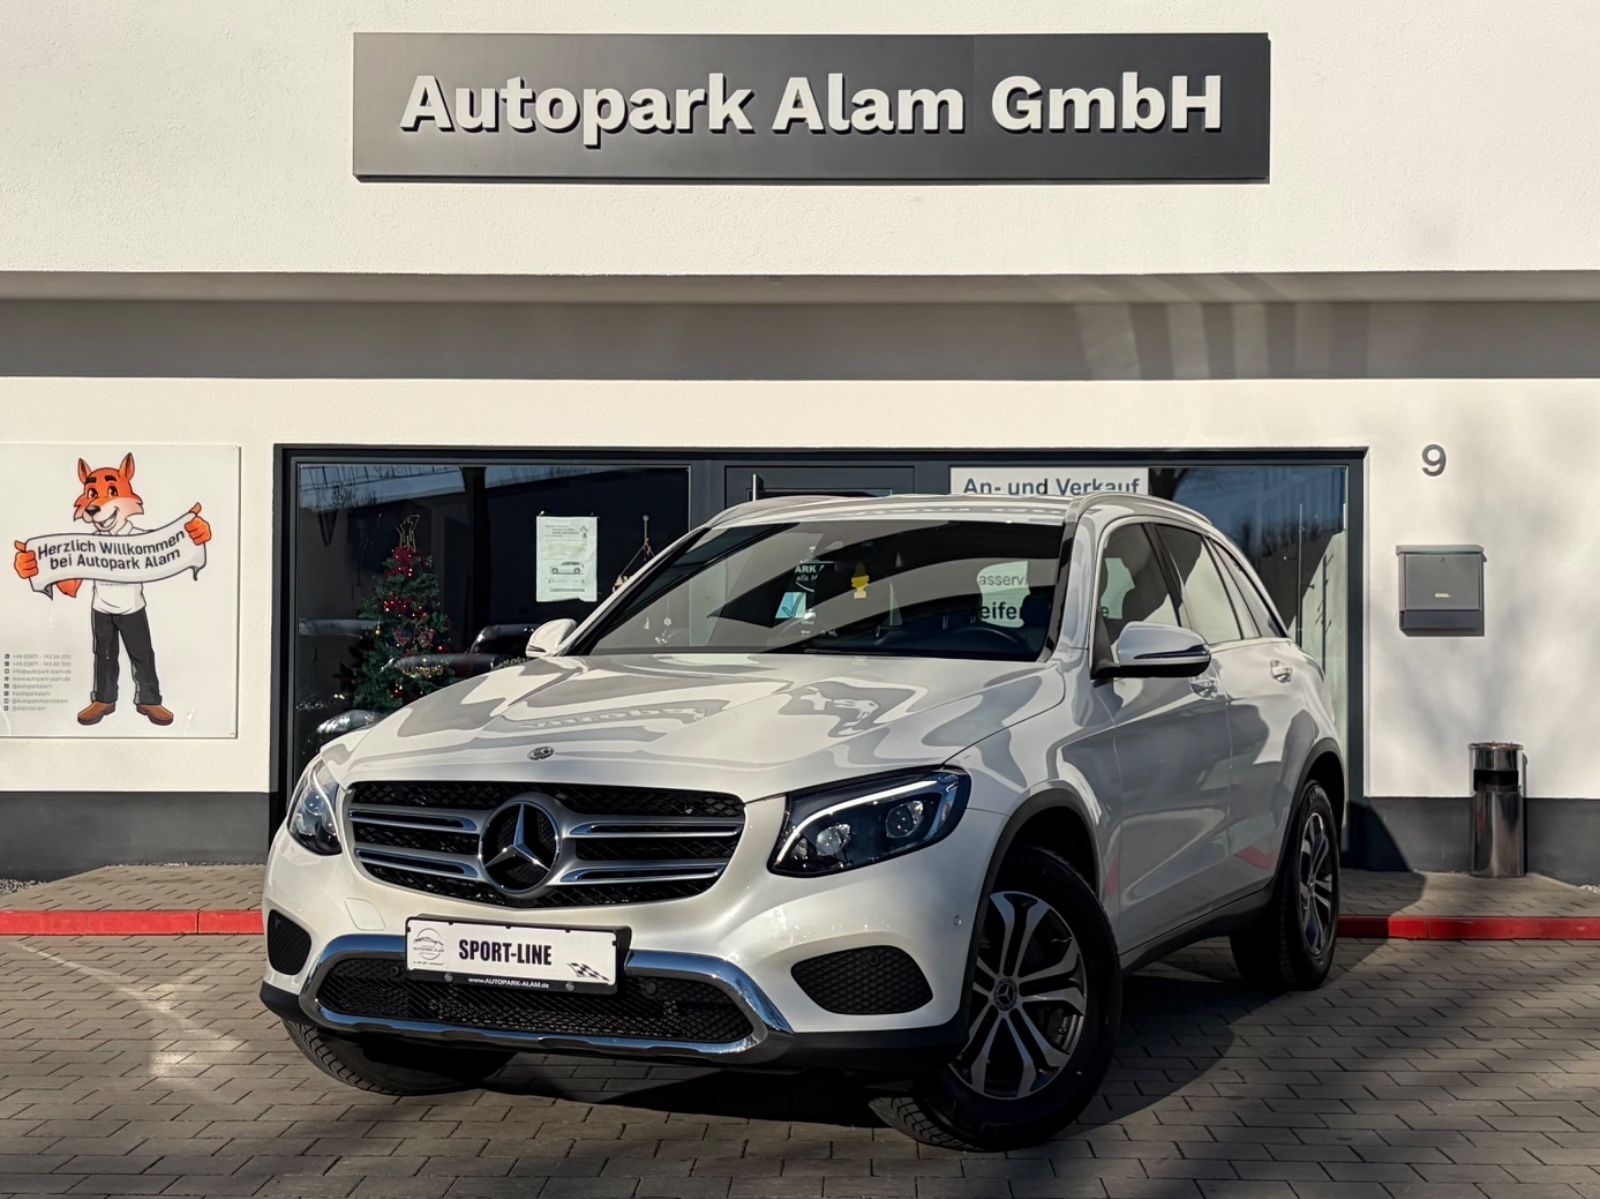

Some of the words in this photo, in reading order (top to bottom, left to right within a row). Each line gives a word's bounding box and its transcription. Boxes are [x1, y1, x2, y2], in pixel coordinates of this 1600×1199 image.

[400, 73, 753, 147] Autopark
[772, 73, 964, 132] Alam
[992, 72, 1221, 131] GmbH
[1422, 444, 1447, 477] 9
[964, 478, 1001, 494] An-
[1008, 478, 1048, 495] und
[38, 539, 95, 560] Herzlich
[100, 530, 185, 556] Willkommen
[50, 554, 72, 570] bei
[77, 555, 140, 571] Autopark
[145, 549, 181, 569] Alam
[459, 939, 552, 966] SPORT-LINE
